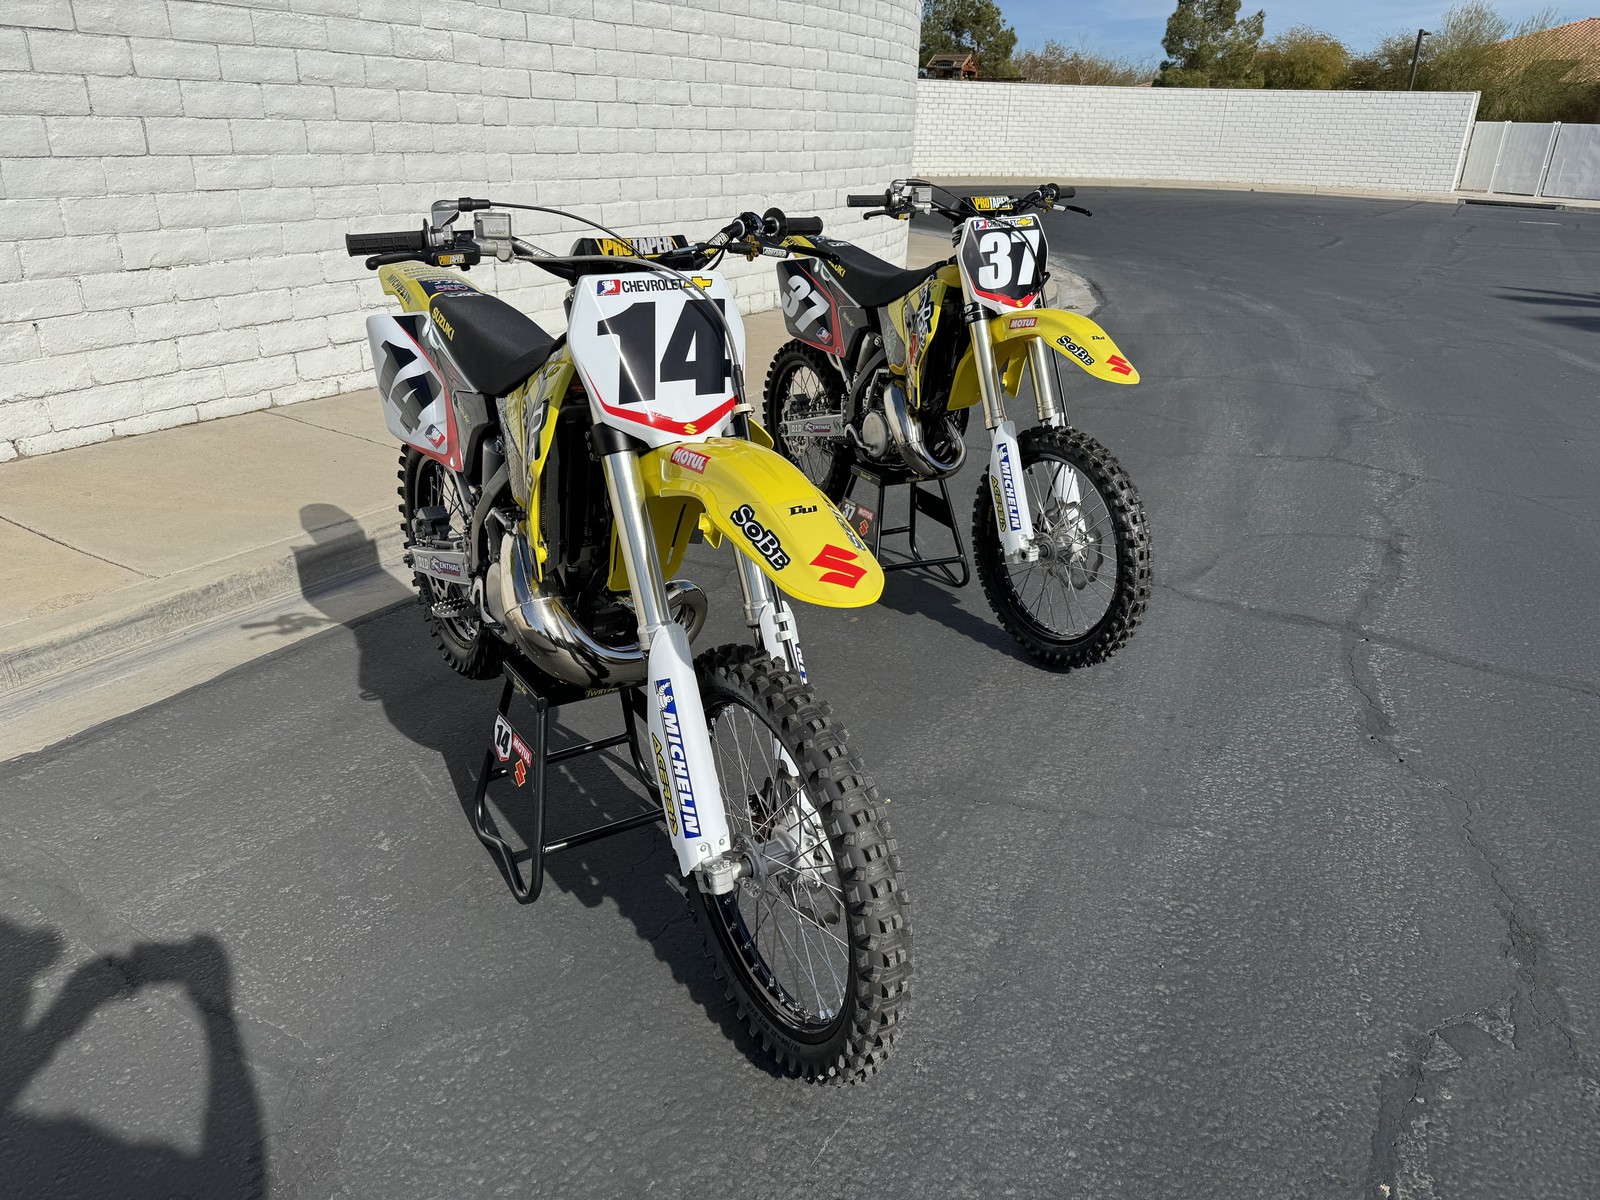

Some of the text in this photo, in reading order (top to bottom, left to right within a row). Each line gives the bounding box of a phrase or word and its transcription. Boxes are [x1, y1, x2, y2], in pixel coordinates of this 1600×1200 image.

[978, 229, 1040, 289] 37
[386, 274, 411, 305] MICHELIN
[622, 279, 683, 293] CHEVROLET
[782, 275, 830, 332] 37
[432, 306, 455, 341] SUZUKI
[1010, 318, 1036, 328] MOTUL
[597, 299, 732, 405] 14
[377, 340, 442, 435] 14
[671, 448, 706, 471] MOTUL
[842, 503, 856, 521] 37
[1001, 461, 1021, 531] MICHELIN
[496, 724, 511, 756] 14
[512, 736, 531, 765] MOTUL
[664, 710, 700, 834] MICHELIN
